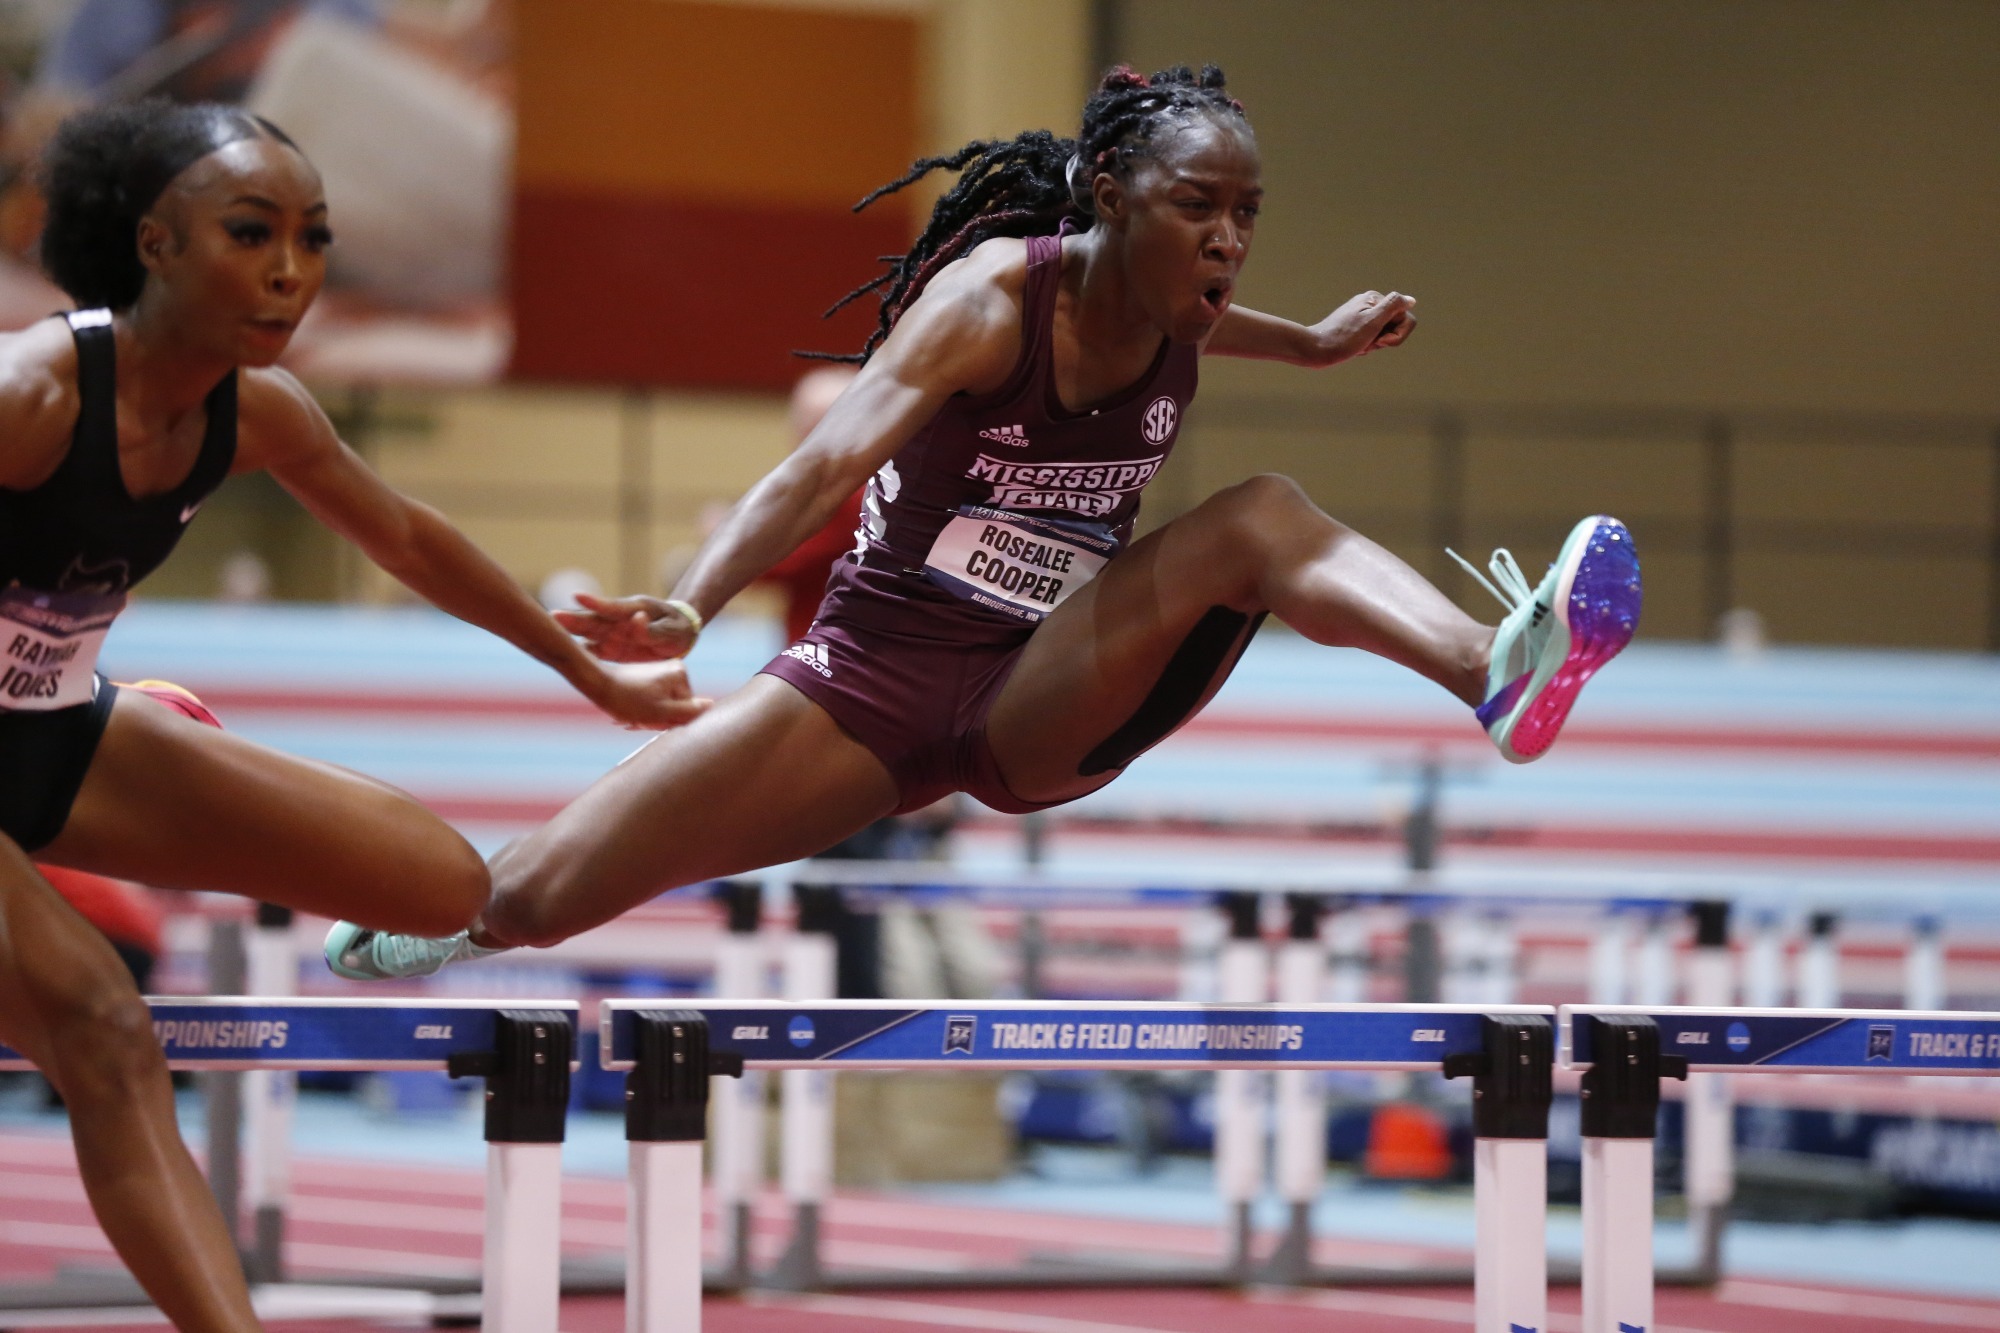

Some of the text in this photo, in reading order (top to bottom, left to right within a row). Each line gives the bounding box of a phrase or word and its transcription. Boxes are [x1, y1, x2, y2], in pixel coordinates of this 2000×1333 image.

[1145, 399, 1175, 442] SEC
[979, 429, 1030, 448] adidas
[1013, 492, 1104, 516] STATE
[979, 524, 1076, 574] ROSEALEE
[966, 550, 1064, 605] COOPER
[1025, 611, 1040, 622] NM
[781, 649, 833, 679] adidas
[414, 1025, 453, 1039] GILL
[732, 1026, 769, 1040] GILL
[992, 1023, 1304, 1050] TRACK & FIELD CHAMPIONSHIPS
[1411, 1029, 1446, 1042] GILL
[1676, 1031, 1710, 1044] GILL
[1908, 1032, 1970, 1058] TRACK
[1970, 1033, 1986, 1058] &
